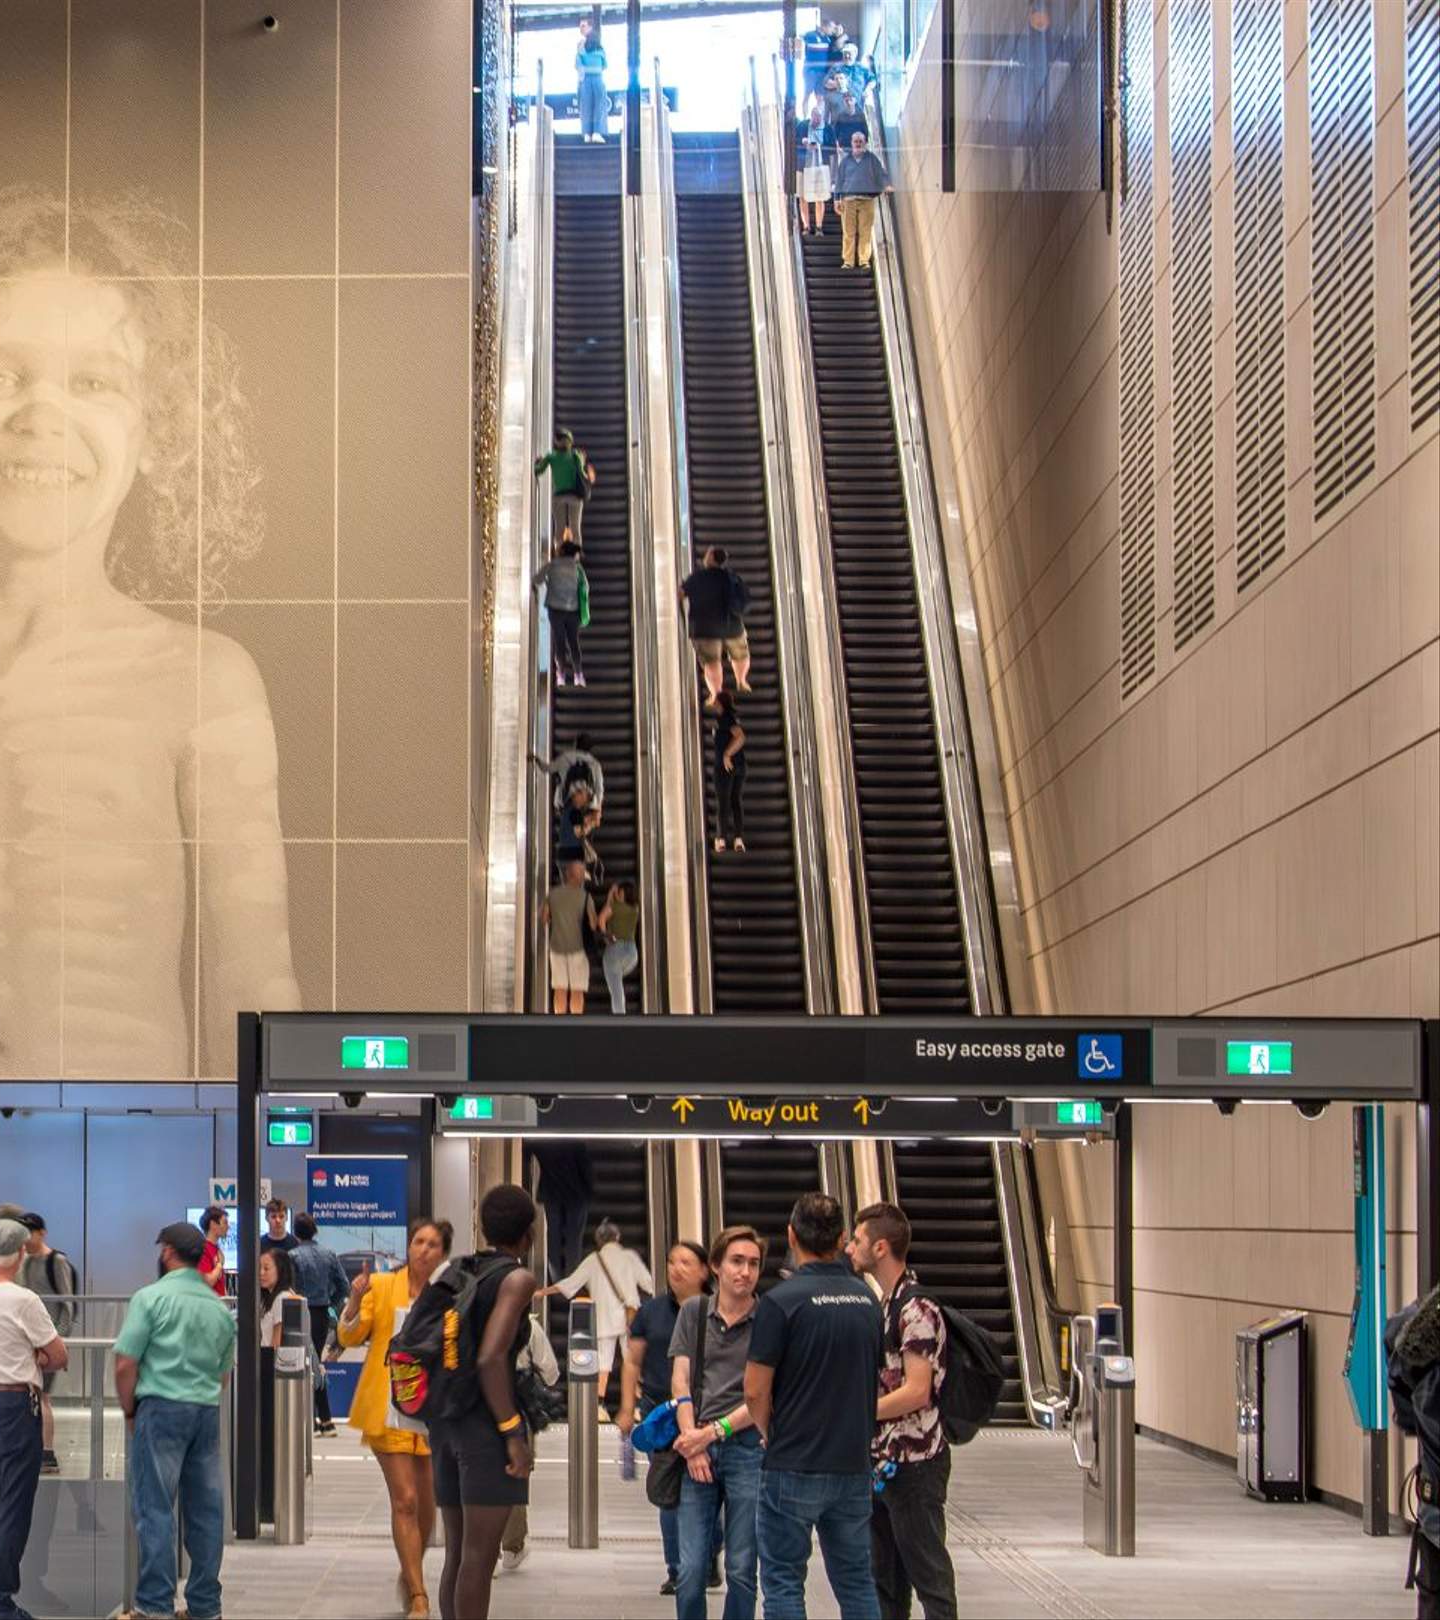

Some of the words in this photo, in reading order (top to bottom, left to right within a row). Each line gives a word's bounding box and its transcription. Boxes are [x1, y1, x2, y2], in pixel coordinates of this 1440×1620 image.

[916, 1039, 956, 1061] Easy
[960, 1042, 1022, 1057] access
[1025, 1041, 1065, 1062] gate
[728, 1099, 777, 1126] Way
[780, 1101, 819, 1122] out
[214, 1184, 236, 1200] M
